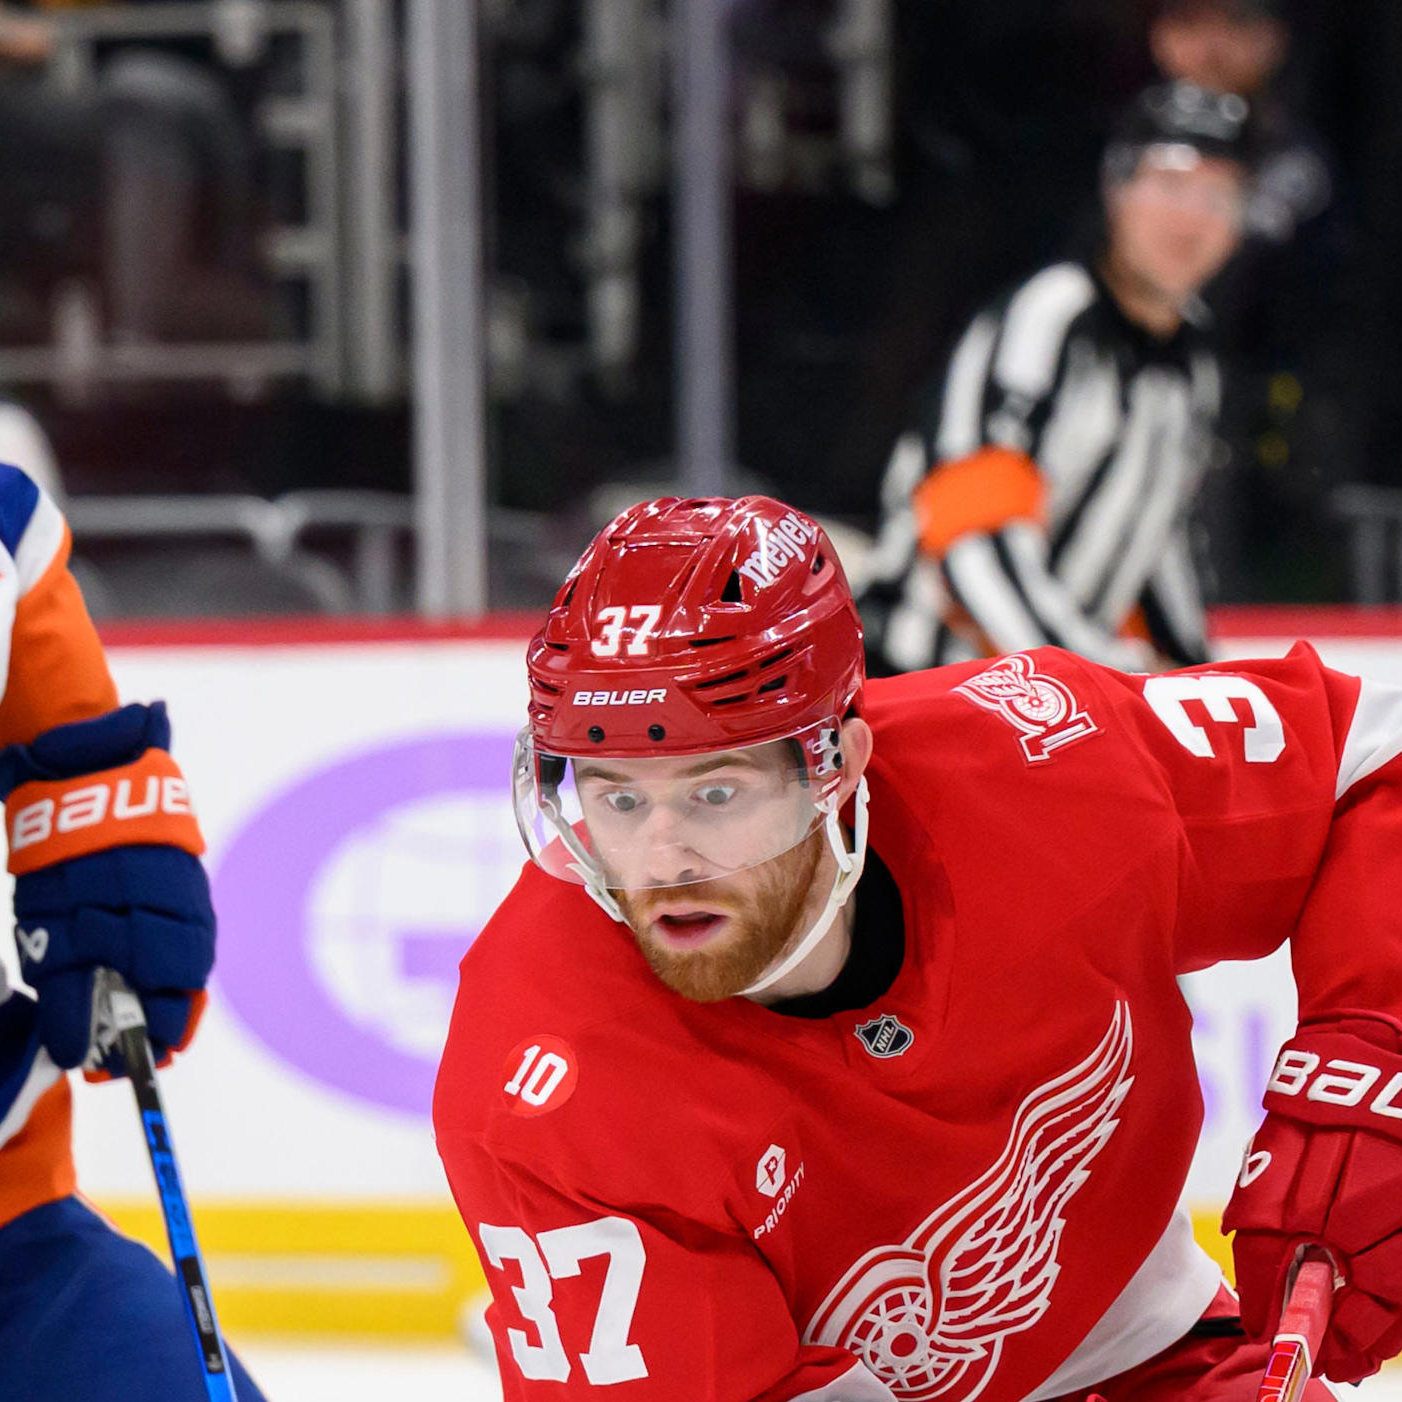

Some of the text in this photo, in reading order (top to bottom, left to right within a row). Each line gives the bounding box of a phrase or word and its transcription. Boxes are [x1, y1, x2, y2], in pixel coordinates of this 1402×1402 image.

[590, 604, 662, 657] 37
[13, 776, 200, 851] BAUE
[504, 1045, 568, 1106] 10
[754, 1161, 804, 1239] PRIORITY
[479, 1216, 648, 1385] 37
